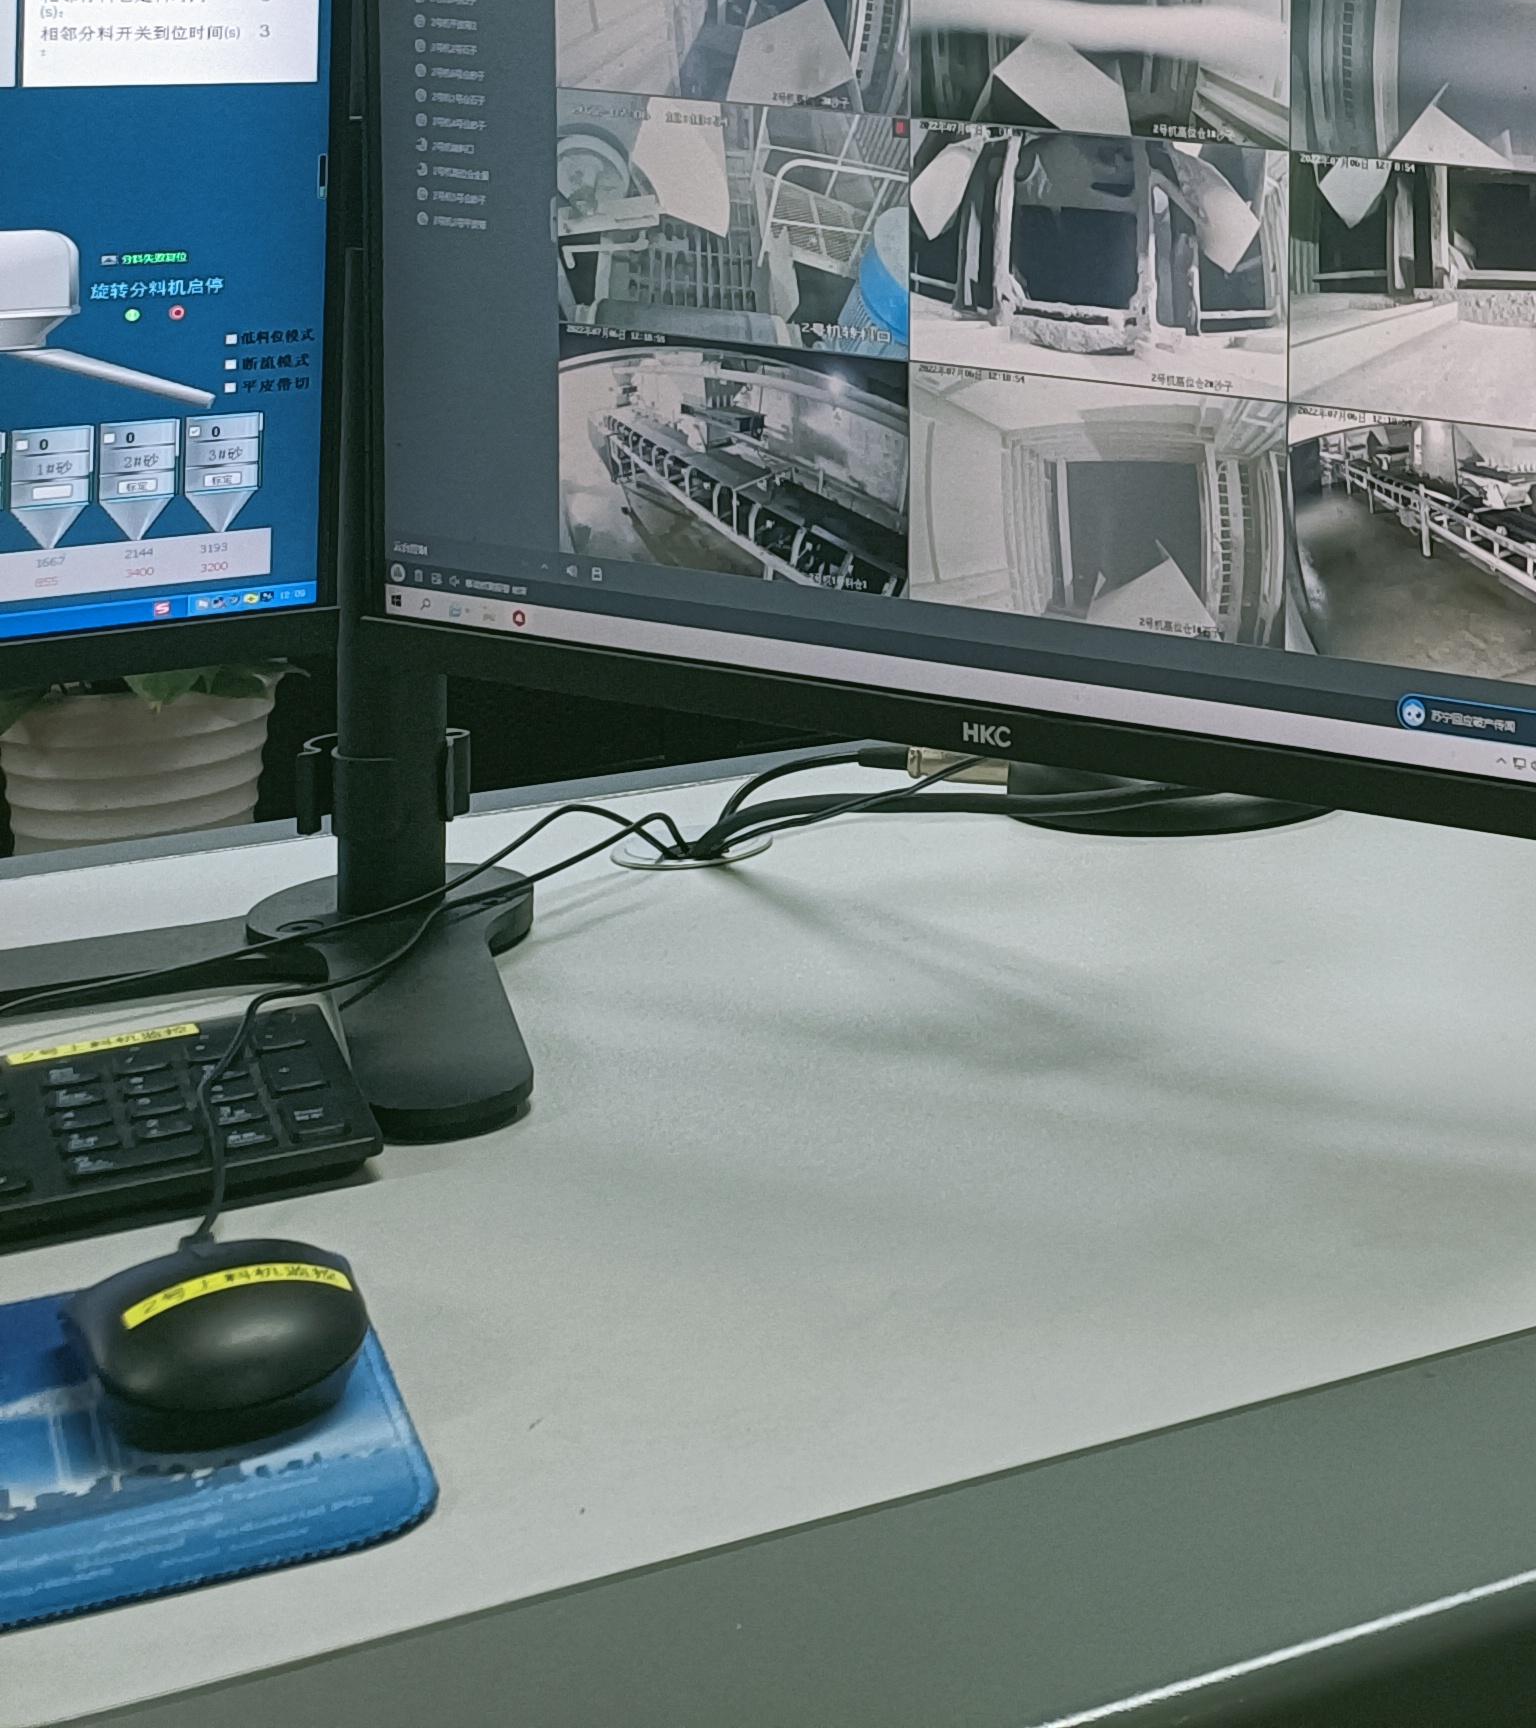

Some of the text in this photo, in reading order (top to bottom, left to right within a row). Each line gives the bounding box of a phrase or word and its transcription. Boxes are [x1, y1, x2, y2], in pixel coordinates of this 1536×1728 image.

[260, 25, 270, 37] 3
[90, 278, 224, 300] 旋转分料机启停
[126, 432, 135, 444] 0
[211, 426, 220, 438] 0
[39, 439, 49, 451] 0
[125, 546, 153, 559] 2144
[200, 541, 228, 553] 3193
[201, 560, 228, 572] 3200
[962, 722, 1011, 748] HKC
